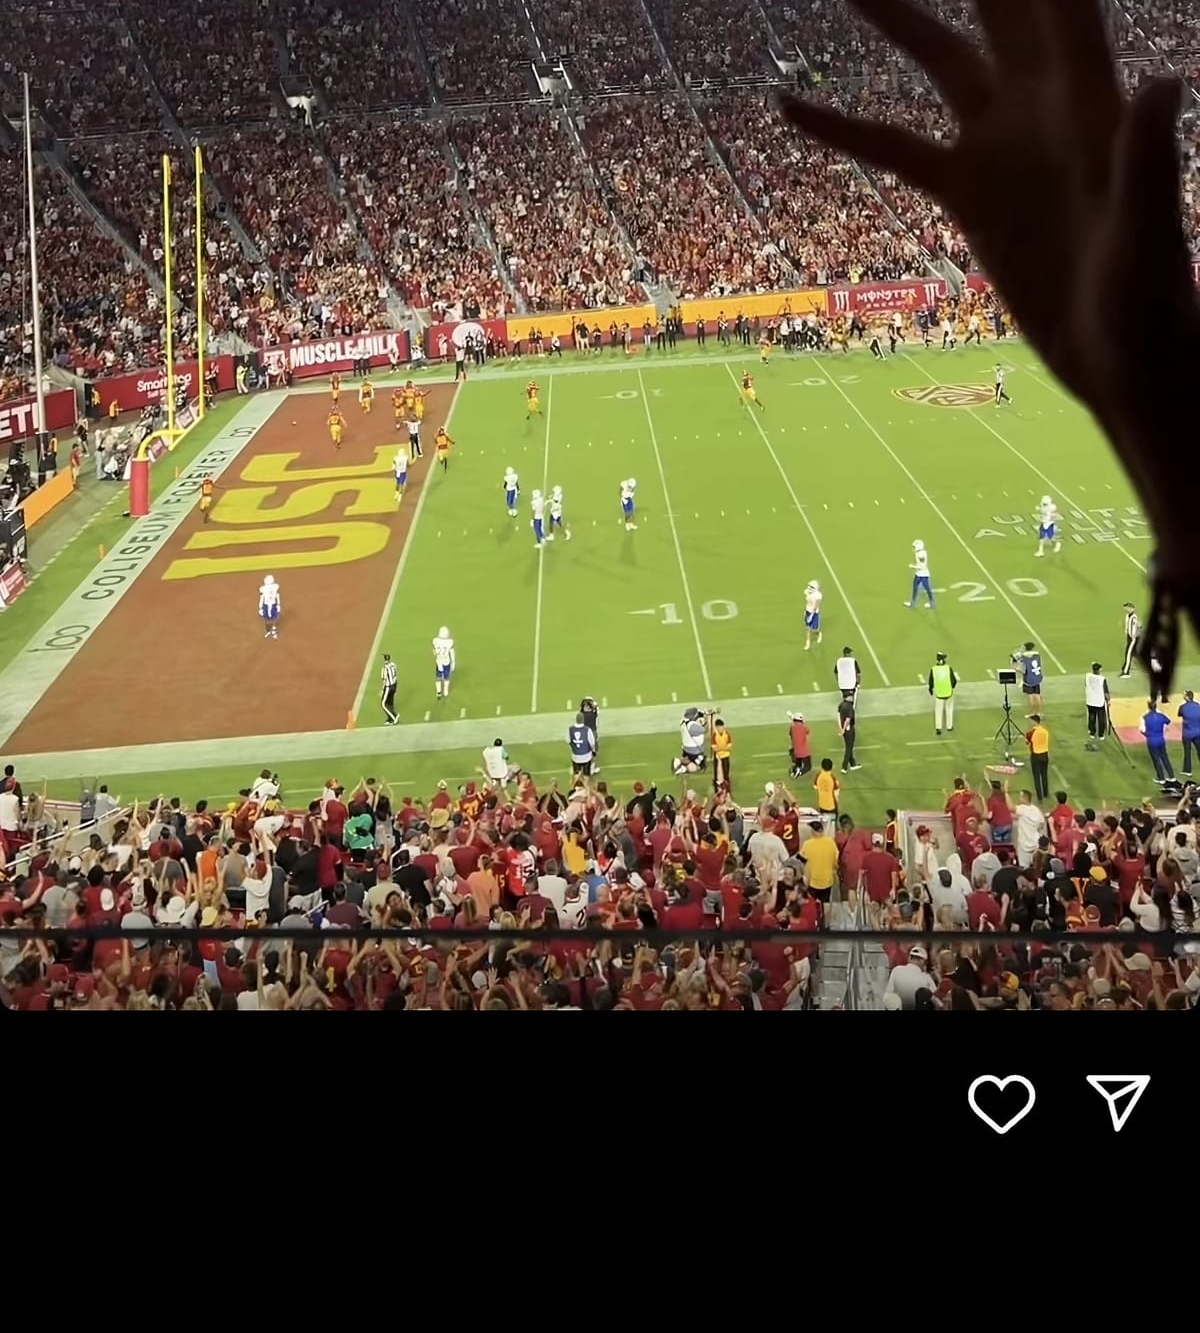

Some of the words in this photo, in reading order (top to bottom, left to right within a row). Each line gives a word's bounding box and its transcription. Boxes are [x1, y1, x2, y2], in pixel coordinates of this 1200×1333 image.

[290, 339, 355, 369] MUSCLE
[161, 442, 415, 580] USC
[81, 510, 183, 601] COLISEUM
[949, 577, 1049, 603] 20
[659, 599, 739, 625] 10
[783, 823, 793, 840] 2
